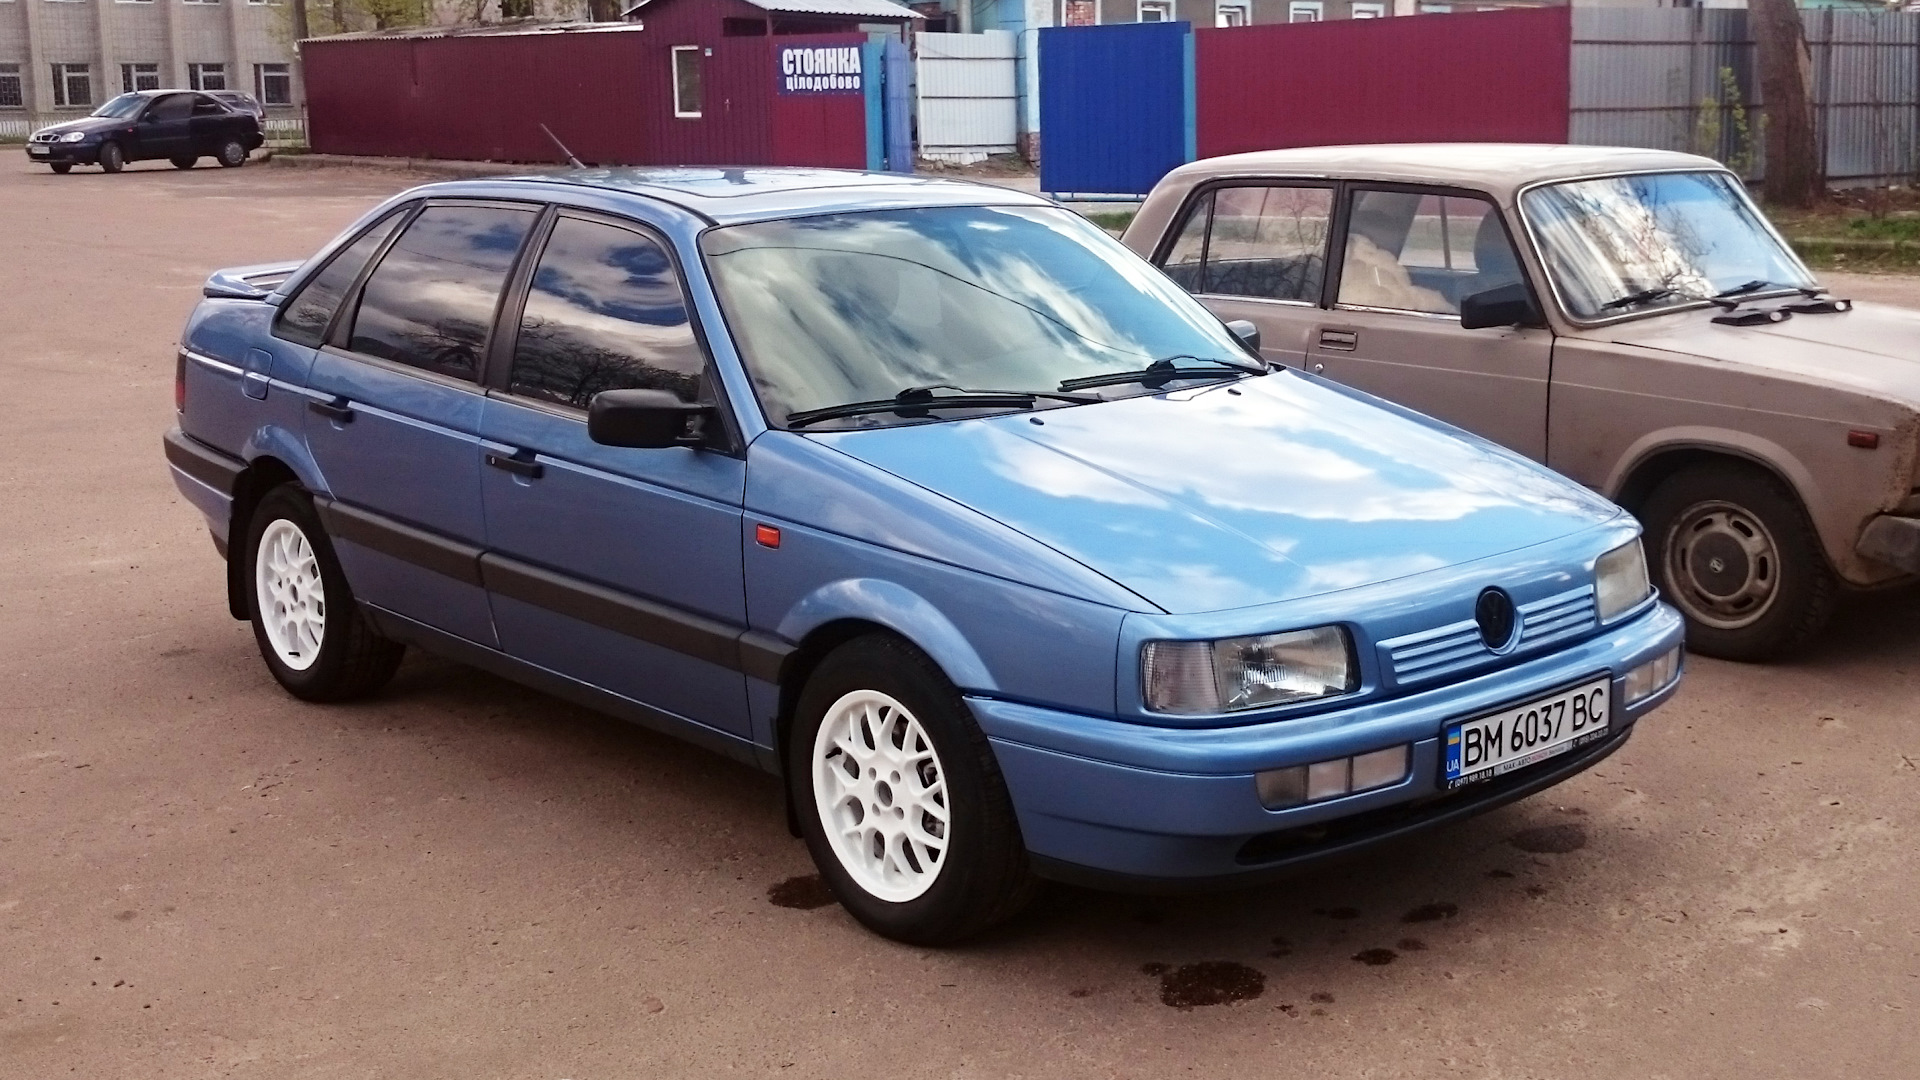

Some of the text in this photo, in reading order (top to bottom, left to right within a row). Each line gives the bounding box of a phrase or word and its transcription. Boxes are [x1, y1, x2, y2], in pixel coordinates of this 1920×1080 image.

[782, 47, 861, 75] СТОЯНКА
[786, 74, 860, 91] цілодобово
[1464, 687, 1604, 767] BM 6037 BC
[1446, 760, 1460, 773] UA
